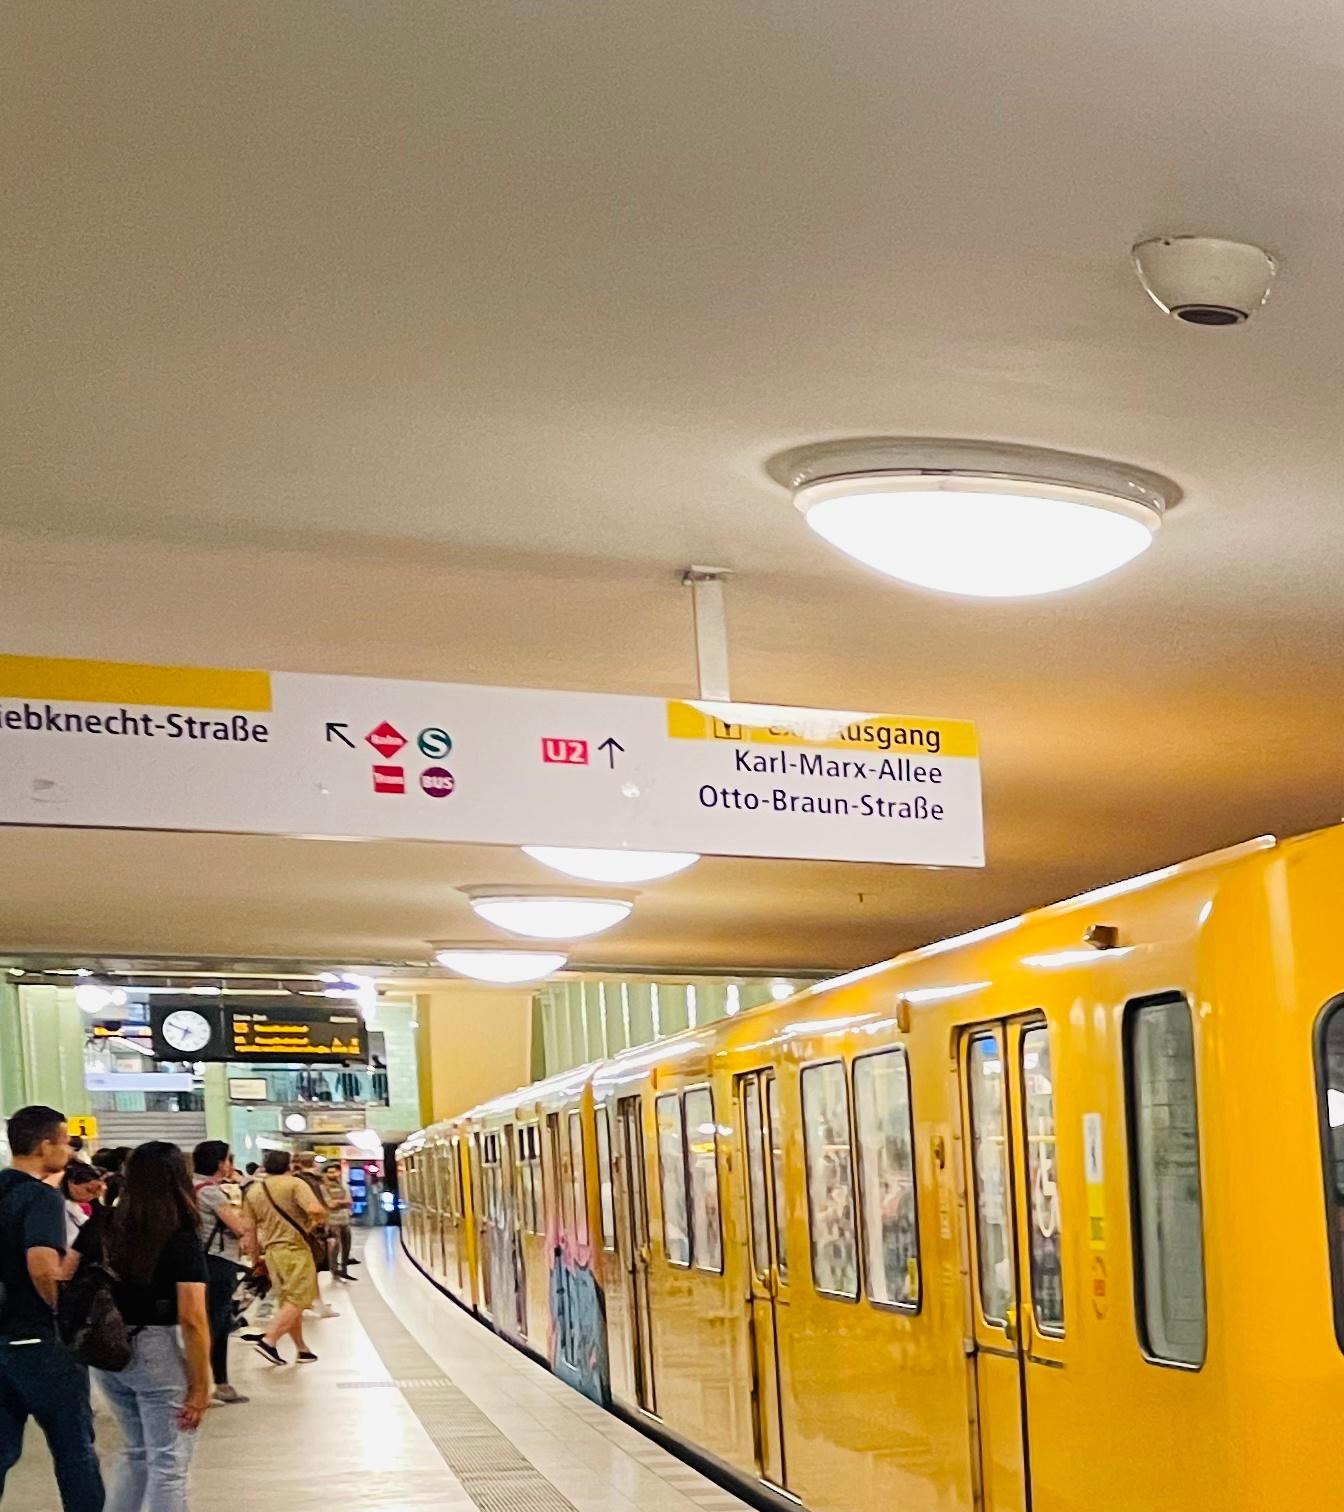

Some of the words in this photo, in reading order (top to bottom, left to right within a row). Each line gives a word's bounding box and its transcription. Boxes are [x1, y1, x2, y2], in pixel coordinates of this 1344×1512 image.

[546, 740, 585, 762] U2
[840, 724, 941, 753] usgang
[735, 749, 942, 784] Karl-Marx-Allee
[421, 775, 454, 790] BUS
[699, 785, 944, 820] Otto-Braun-Straße
